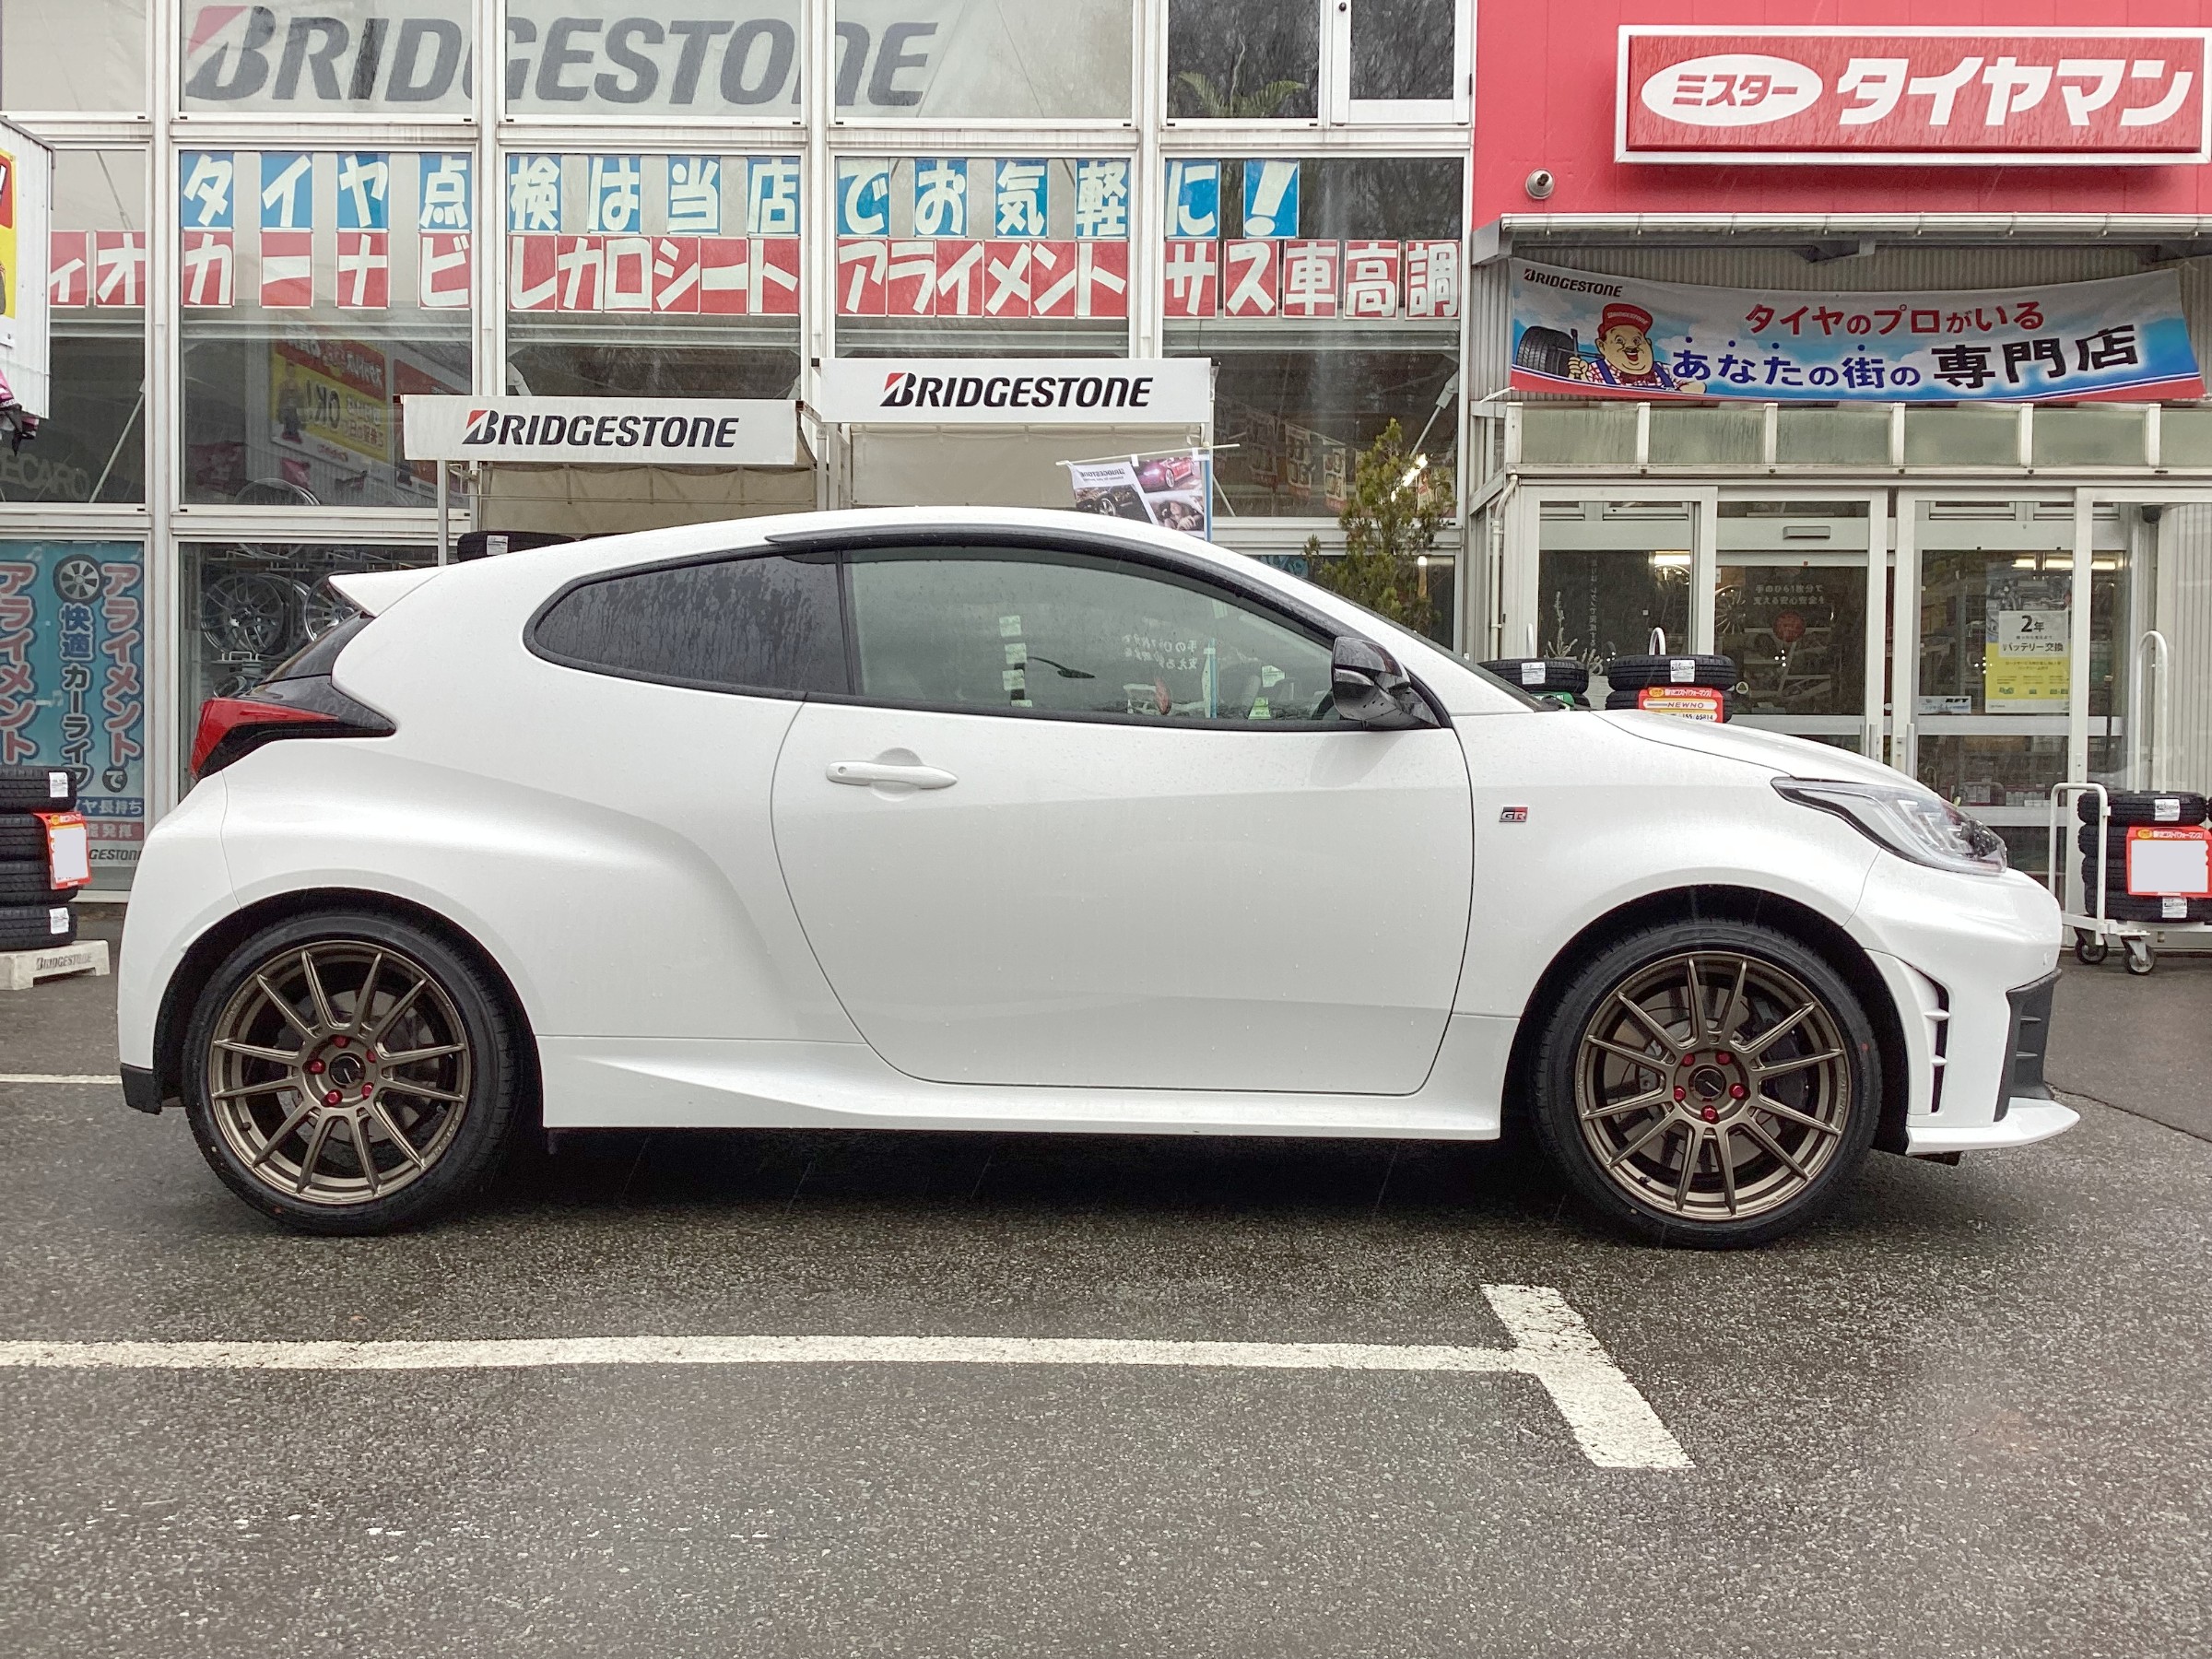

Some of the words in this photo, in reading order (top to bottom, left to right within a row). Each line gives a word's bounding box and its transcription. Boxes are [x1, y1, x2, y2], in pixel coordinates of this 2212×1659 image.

[186, 6, 938, 106] BRIDGESTONE
[1673, 74, 1798, 107] ミスター
[1838, 56, 2194, 126] タイヤマン
[184, 232, 470, 308] カーナビ
[511, 237, 798, 313] レカロシート
[839, 240, 1126, 316] アライメント
[1524, 268, 1623, 297] BRIDGESTONE
[1745, 301, 2044, 336] タイヤのプロがいる
[879, 371, 1154, 408] BRIDGESTONE
[462, 409, 738, 448] BRIDGESTONE
[2020, 615, 2045, 633] 2年
